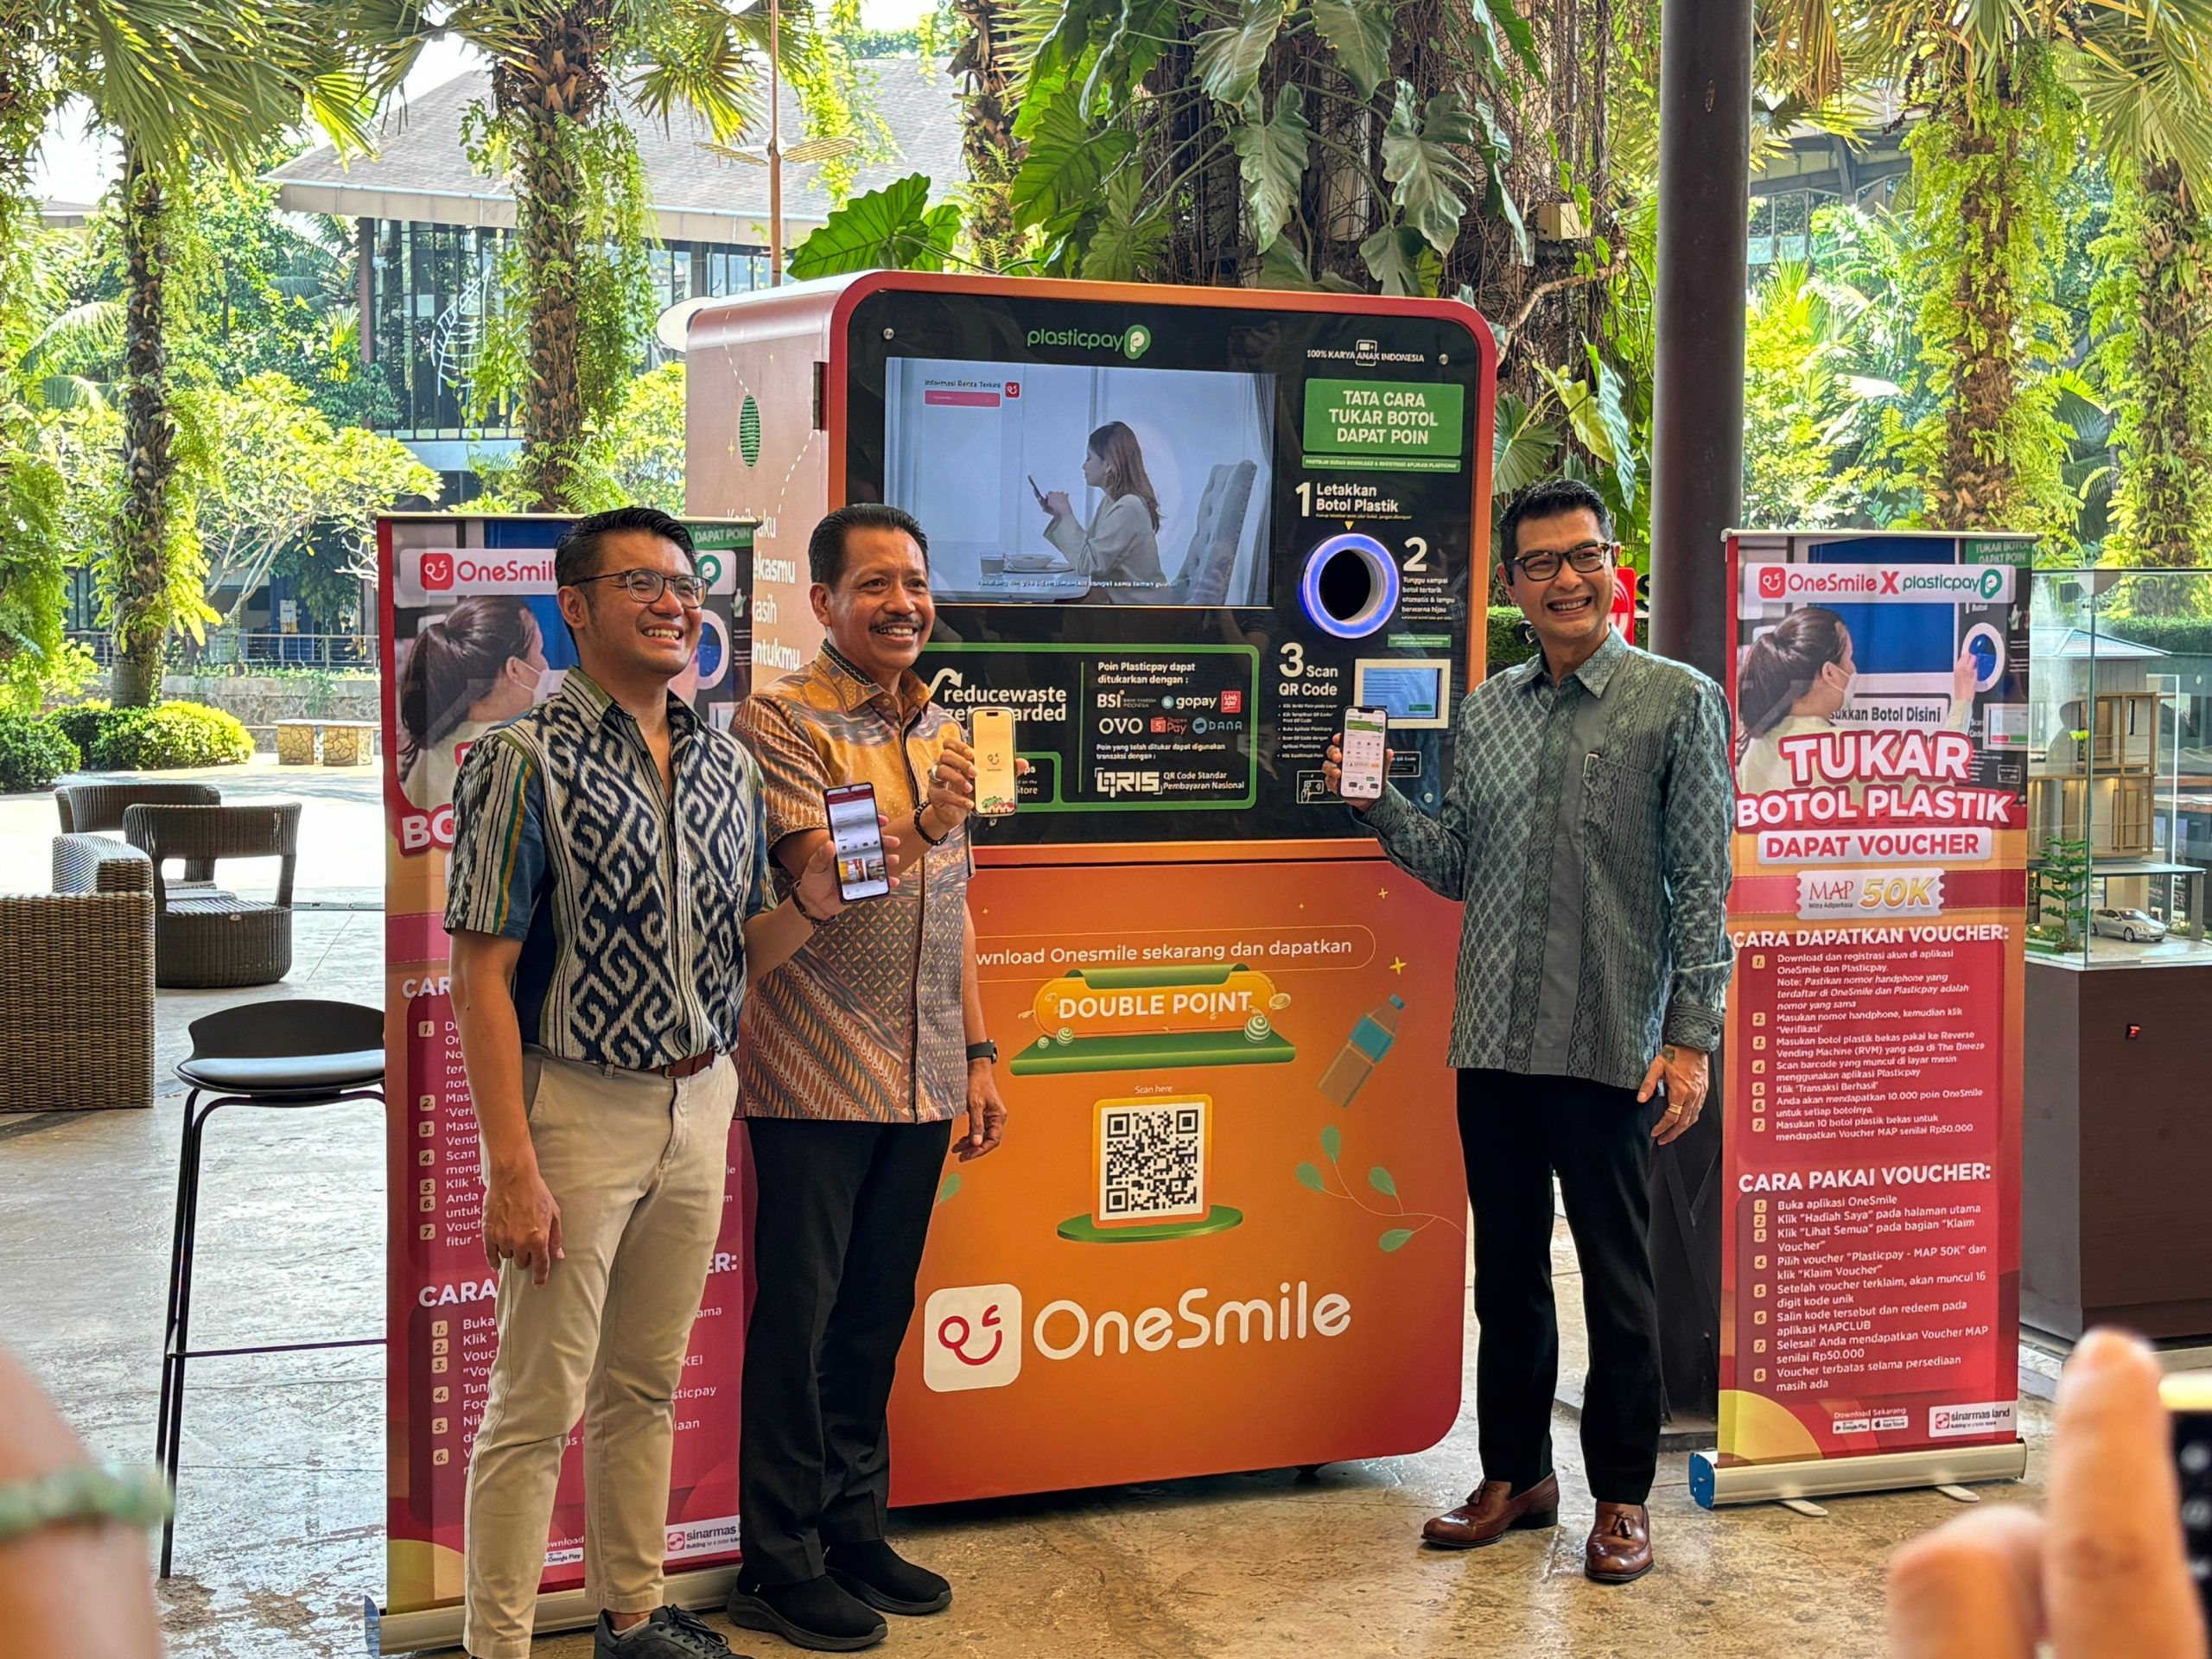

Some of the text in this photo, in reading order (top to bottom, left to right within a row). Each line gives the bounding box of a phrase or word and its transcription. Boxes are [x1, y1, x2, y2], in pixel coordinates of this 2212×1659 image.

[1027, 328, 1123, 351] plasticpay
[1382, 353, 1424, 362] INDONESIA
[1344, 391, 1425, 407] TATA CARA
[1329, 409, 1438, 426] TUKAR BOTOL
[1337, 428, 1428, 444] DAPAT POIN
[1295, 482, 1376, 517] 1 Letakkan
[1316, 499, 1398, 512] Botol Plastik
[695, 528, 751, 543] DAPAT POIN
[1403, 537, 1427, 571] 2
[457, 560, 552, 582] OneSmil
[753, 550, 795, 583] ekasmu
[1788, 570, 1980, 594] OneSmile X plasticpay
[753, 594, 777, 624] asih
[1098, 662, 1195, 673] Poin Plasticpay dapat
[1280, 643, 1338, 678] 3 Scan
[1097, 675, 1147, 683] ditukarkan
[1149, 676, 1183, 686] dengan
[944, 684, 1066, 702] reducewaste
[1279, 683, 1338, 696] QR Code
[1097, 693, 1121, 708] BSI
[1176, 696, 1217, 709] gopay
[1014, 703, 1066, 721] arded
[1872, 707, 1903, 721] Botol
[1907, 707, 1941, 722] Disini
[1099, 717, 1243, 734] OVO Pay DANA
[1783, 734, 1971, 782] TUKAR
[1163, 782, 1210, 791] Pembayaran
[1738, 792, 2012, 826] BOTOL PLASTIK
[1766, 834, 1979, 858] DAPAT VOUCHER
[1809, 878, 1935, 907] MAP 50K
[1733, 924, 2009, 948] CARA DAPATKAN VOUCHER:
[976, 938, 1351, 965] wnload Onesmile sekarang dan dapatkan
[1777, 965, 1821, 974] OneSmile
[403, 976, 449, 998] CAR
[1058, 991, 1253, 1020] DOUBLE POINT
[1777, 1049, 1814, 1058] Vending
[1815, 1047, 1852, 1056] Machine
[1854, 1046, 1883, 1055] (RVM)
[1885, 1046, 1906, 1055] yang
[1908, 1044, 1924, 1052] ada
[1135, 1084, 1173, 1095] Scan here
[447, 1151, 475, 1161] Scan
[446, 1178, 468, 1189] Klik
[1738, 1163, 1990, 1192] CARA PAKAI VOUCHER:
[446, 1192, 478, 1204] Anda
[1778, 1194, 1897, 1210] Buka aplikasi OneSmile
[447, 1205, 480, 1217] untuk
[446, 1236, 472, 1247] fitur
[1777, 1271, 1986, 1294] Setelah voucher terklaim, akan muncul 16
[419, 1279, 498, 1306] CARA
[1777, 1294, 1853, 1309] digit kode unik
[1777, 1300, 1967, 1321] Salin kode tersebut dan redeem pada
[464, 1317, 495, 1330] Buka
[1033, 1281, 1351, 1360] OneSmile
[1777, 1320, 1870, 1337] aplikasi MAPCLUB
[464, 1333, 486, 1346] Klik
[1777, 1325, 1988, 1350] Selesai! Anda mendapatkan Voucher MAP
[1777, 1348, 1864, 1363] senilai Rp50.000
[1777, 1356, 1961, 1377] Voucher terbatas selama persediaan
[671, 1386, 716, 1400] sticpay
[1777, 1379, 1828, 1391] masih ada
[1834, 1408, 1906, 1419] Download Sekarang
[1951, 1408, 2009, 1421] sinarmas land
[686, 1525, 736, 1541] sinarmas
[545, 1536, 584, 1548] ownload
